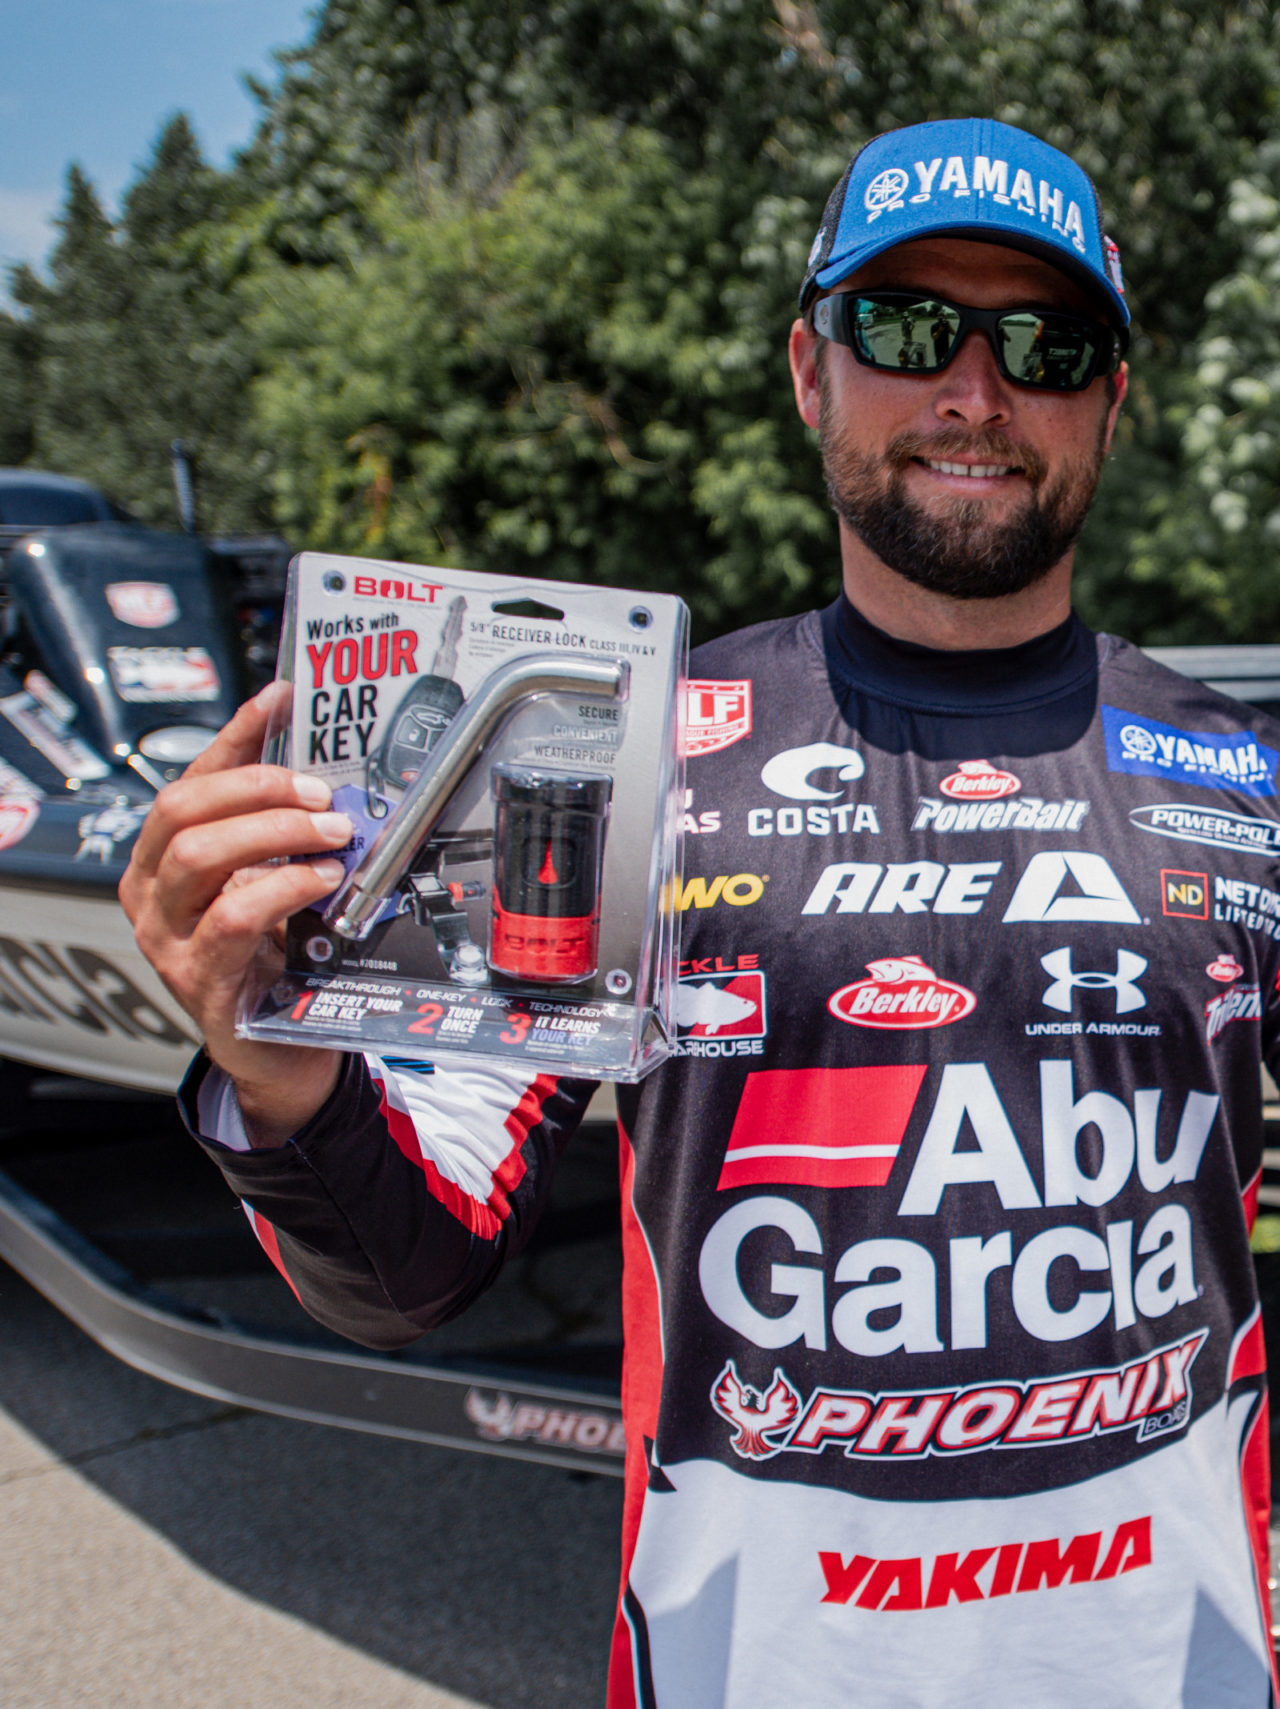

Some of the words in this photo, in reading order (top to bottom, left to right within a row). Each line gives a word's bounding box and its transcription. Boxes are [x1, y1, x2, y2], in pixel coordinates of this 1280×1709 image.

[914, 156, 1085, 243] YAMAHA
[354, 576, 443, 603] BOLT
[307, 614, 364, 640] Works
[369, 612, 399, 630] with
[492, 625, 551, 644] RECEIVER
[555, 632, 586, 648] LOCK
[590, 640, 616, 653] CLASS
[306, 629, 418, 689] YOUR
[311, 684, 378, 727] CAR
[578, 706, 618, 720] SECURE
[687, 692, 738, 725] LF
[309, 721, 375, 765] KEY
[554, 724, 617, 742] CONVENIENT
[534, 745, 616, 764] WEATHERPROOF
[951, 775, 1010, 794] Berkley
[747, 803, 880, 836] COSTA
[910, 797, 1090, 832] PowerBait
[801, 861, 1002, 914] ARE
[1168, 883, 1204, 905] ND
[1214, 876, 1260, 908] NET
[678, 953, 760, 976] CKLE
[291, 990, 314, 1020] 1
[306, 977, 401, 996] BREAKTHROUGH
[416, 989, 467, 1002] ONE-KEY
[481, 996, 513, 1008] LOCK
[529, 1002, 602, 1017] TECHNOLOGY
[308, 1003, 337, 1017] CAR
[338, 1006, 367, 1020] KEY
[315, 992, 365, 1008] INSERT
[365, 996, 403, 1012] YOUR
[849, 985, 957, 1022] Berkley
[408, 1002, 444, 1035] 2
[441, 1018, 479, 1034] ONCE
[447, 1006, 484, 1021] TURN
[500, 1013, 531, 1045] 3
[535, 1016, 550, 1028] IT
[551, 1017, 601, 1034] LEARNS
[1025, 1023, 1082, 1036] UNDER
[1086, 1022, 1158, 1037] ARMOUR
[531, 1028, 566, 1043] YOUR
[567, 1031, 593, 1046] KEY
[898, 1060, 1219, 1216] Abu
[699, 1197, 1197, 1356] Garcia
[792, 1332, 1207, 1457] PHOENIX
[513, 1404, 627, 1452] PHOE
[817, 1515, 1152, 1611] YAKIMA
